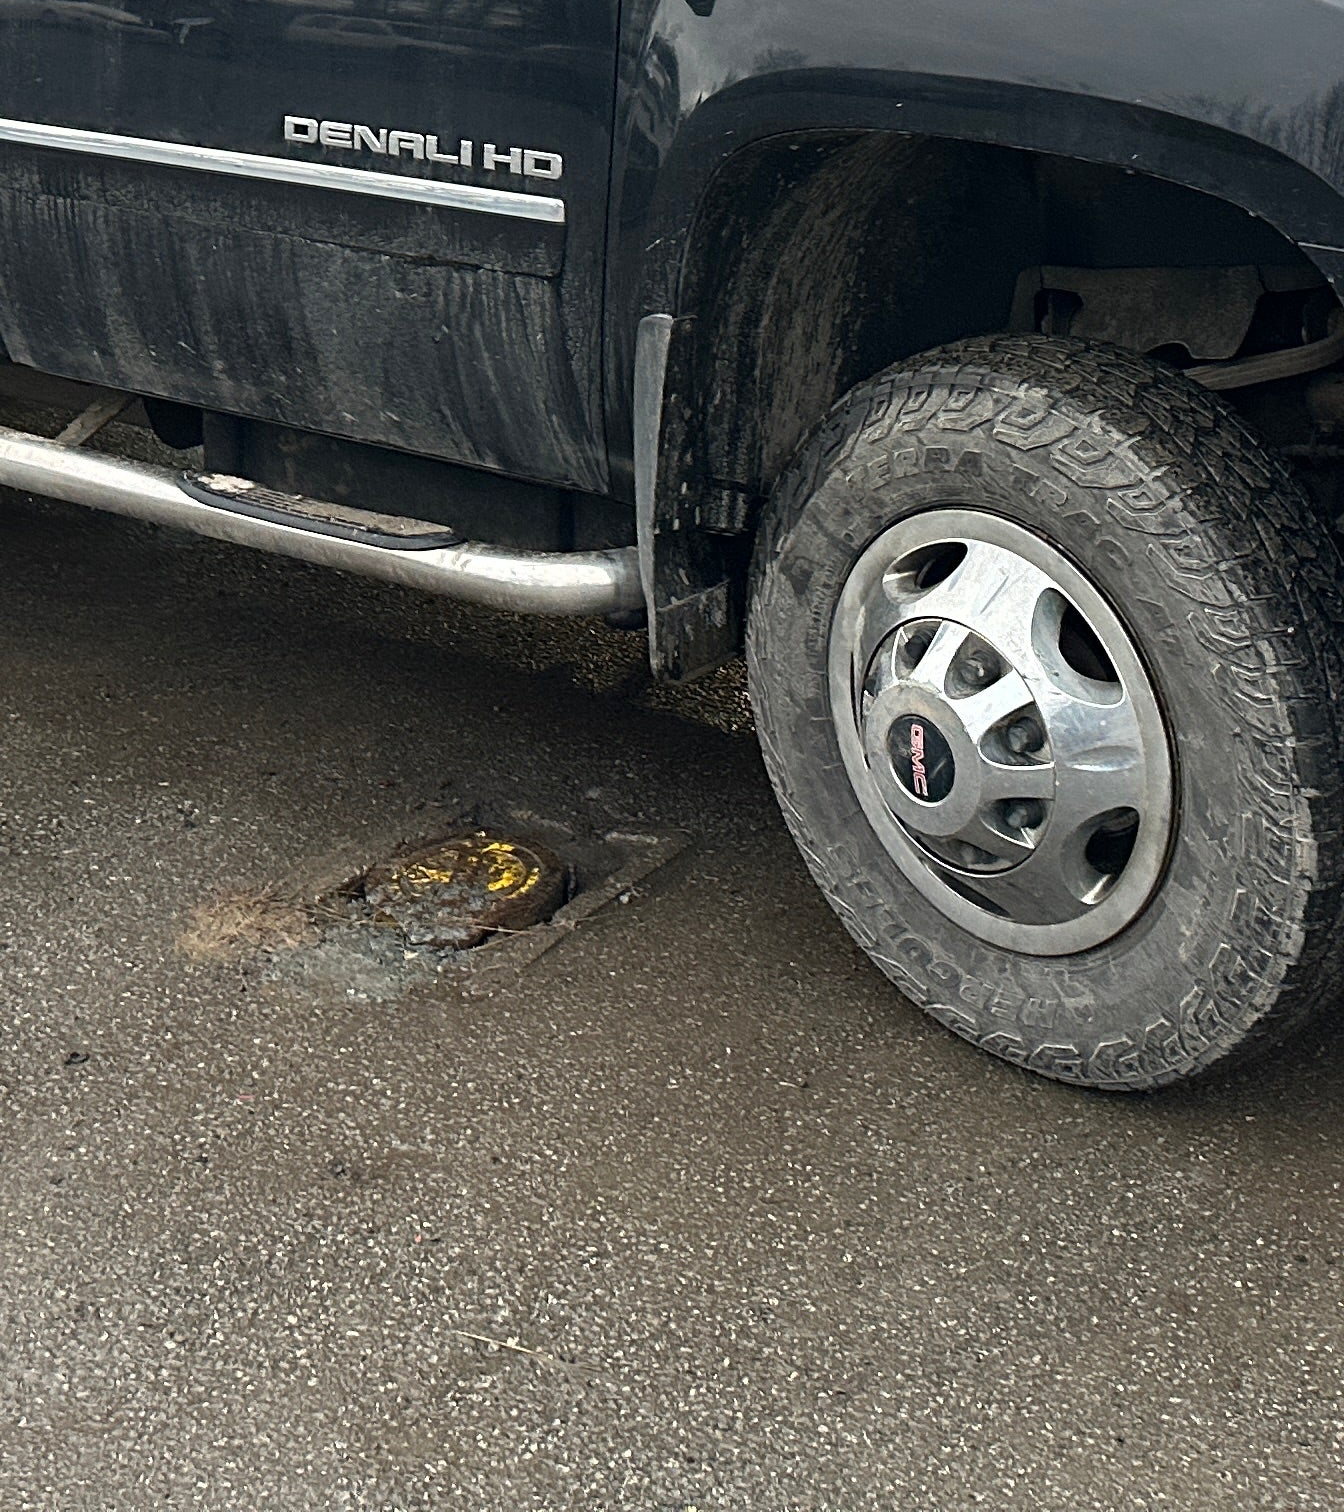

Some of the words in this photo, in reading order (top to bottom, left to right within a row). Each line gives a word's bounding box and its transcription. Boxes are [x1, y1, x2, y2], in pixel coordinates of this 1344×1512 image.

[283, 114, 473, 168] DENALI
[483, 143, 564, 181] HD
[910, 723, 929, 797] GMC
